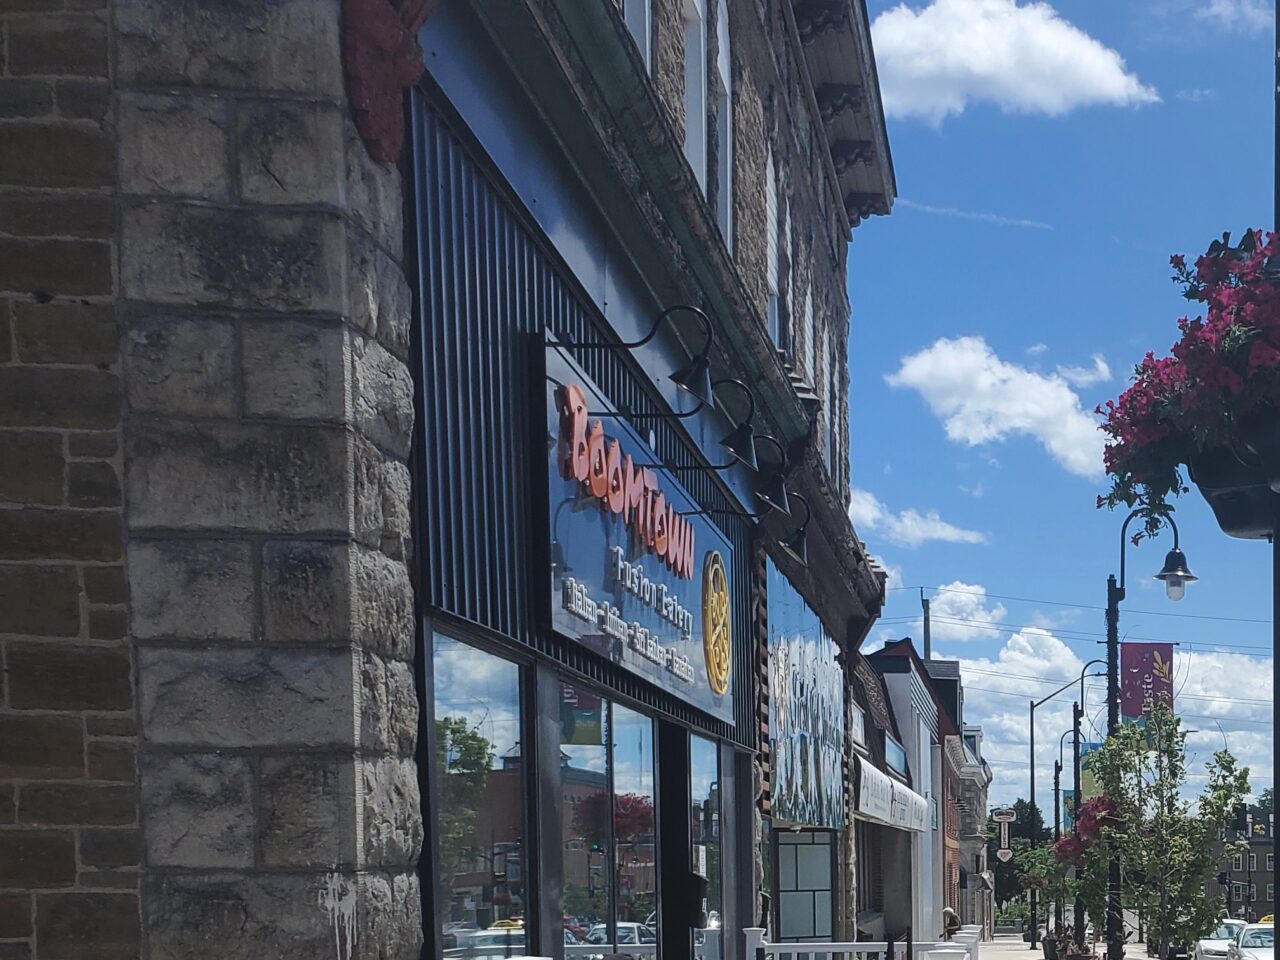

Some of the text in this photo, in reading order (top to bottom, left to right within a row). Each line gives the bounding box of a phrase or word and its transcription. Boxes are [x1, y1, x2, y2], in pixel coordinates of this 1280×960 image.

[566, 384, 696, 580] BOOMTOWN
[611, 545, 693, 640] Fusion Eatery
[1142, 674, 1154, 715] Taste
